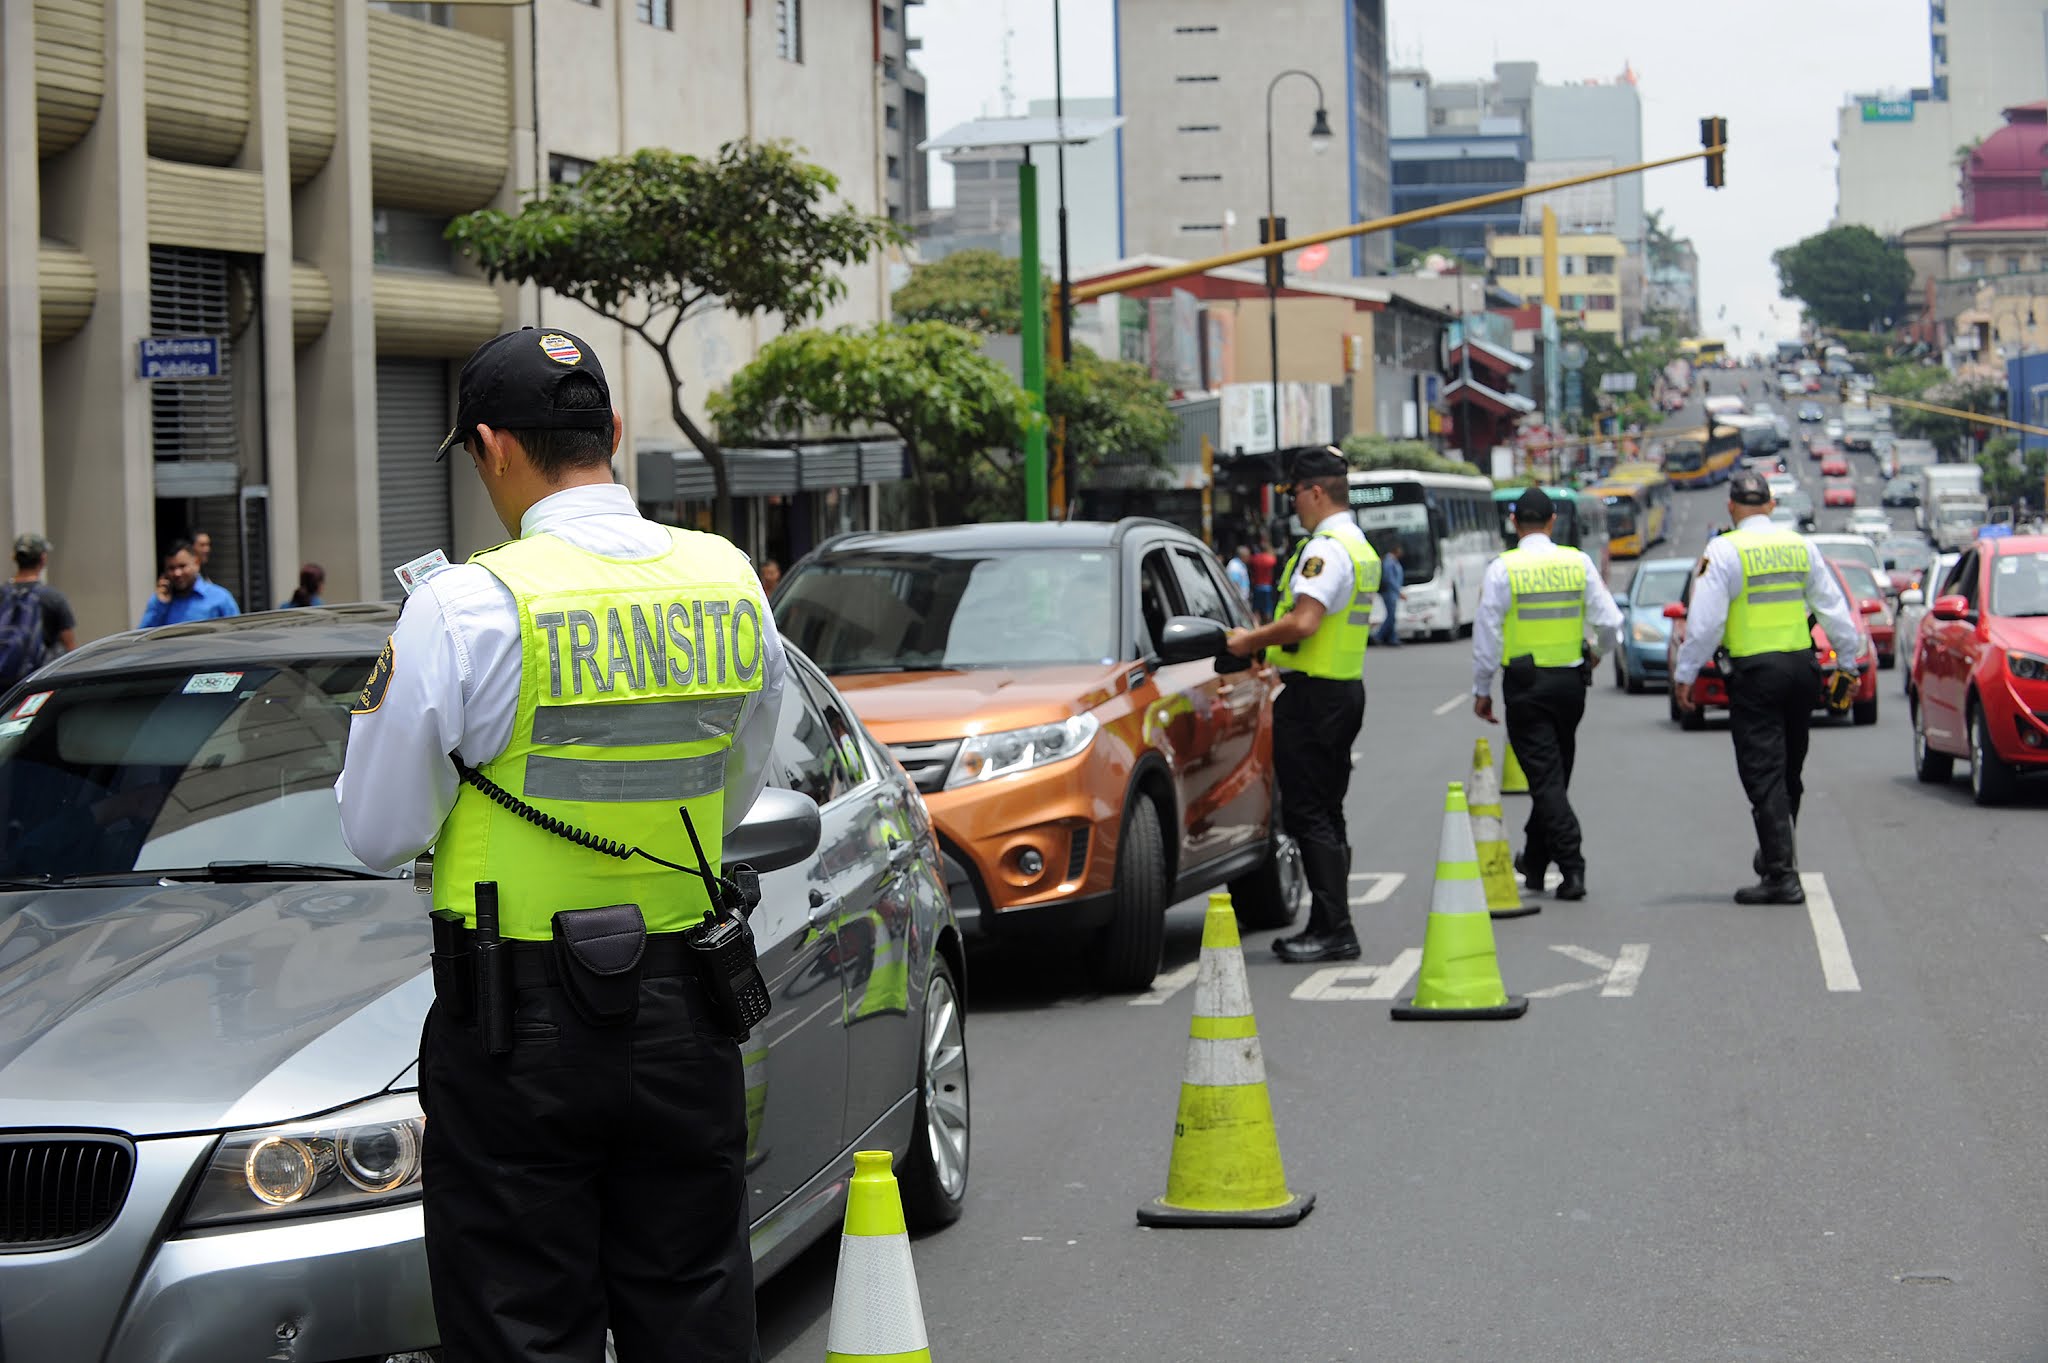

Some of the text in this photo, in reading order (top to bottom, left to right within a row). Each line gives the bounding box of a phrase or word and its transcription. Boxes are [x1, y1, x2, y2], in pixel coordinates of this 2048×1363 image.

[144, 340, 211, 357] Defensa
[1743, 545, 1807, 572] TRANSITO
[1512, 565, 1582, 592] TRANSITO
[535, 598, 760, 698] TRANSITO
